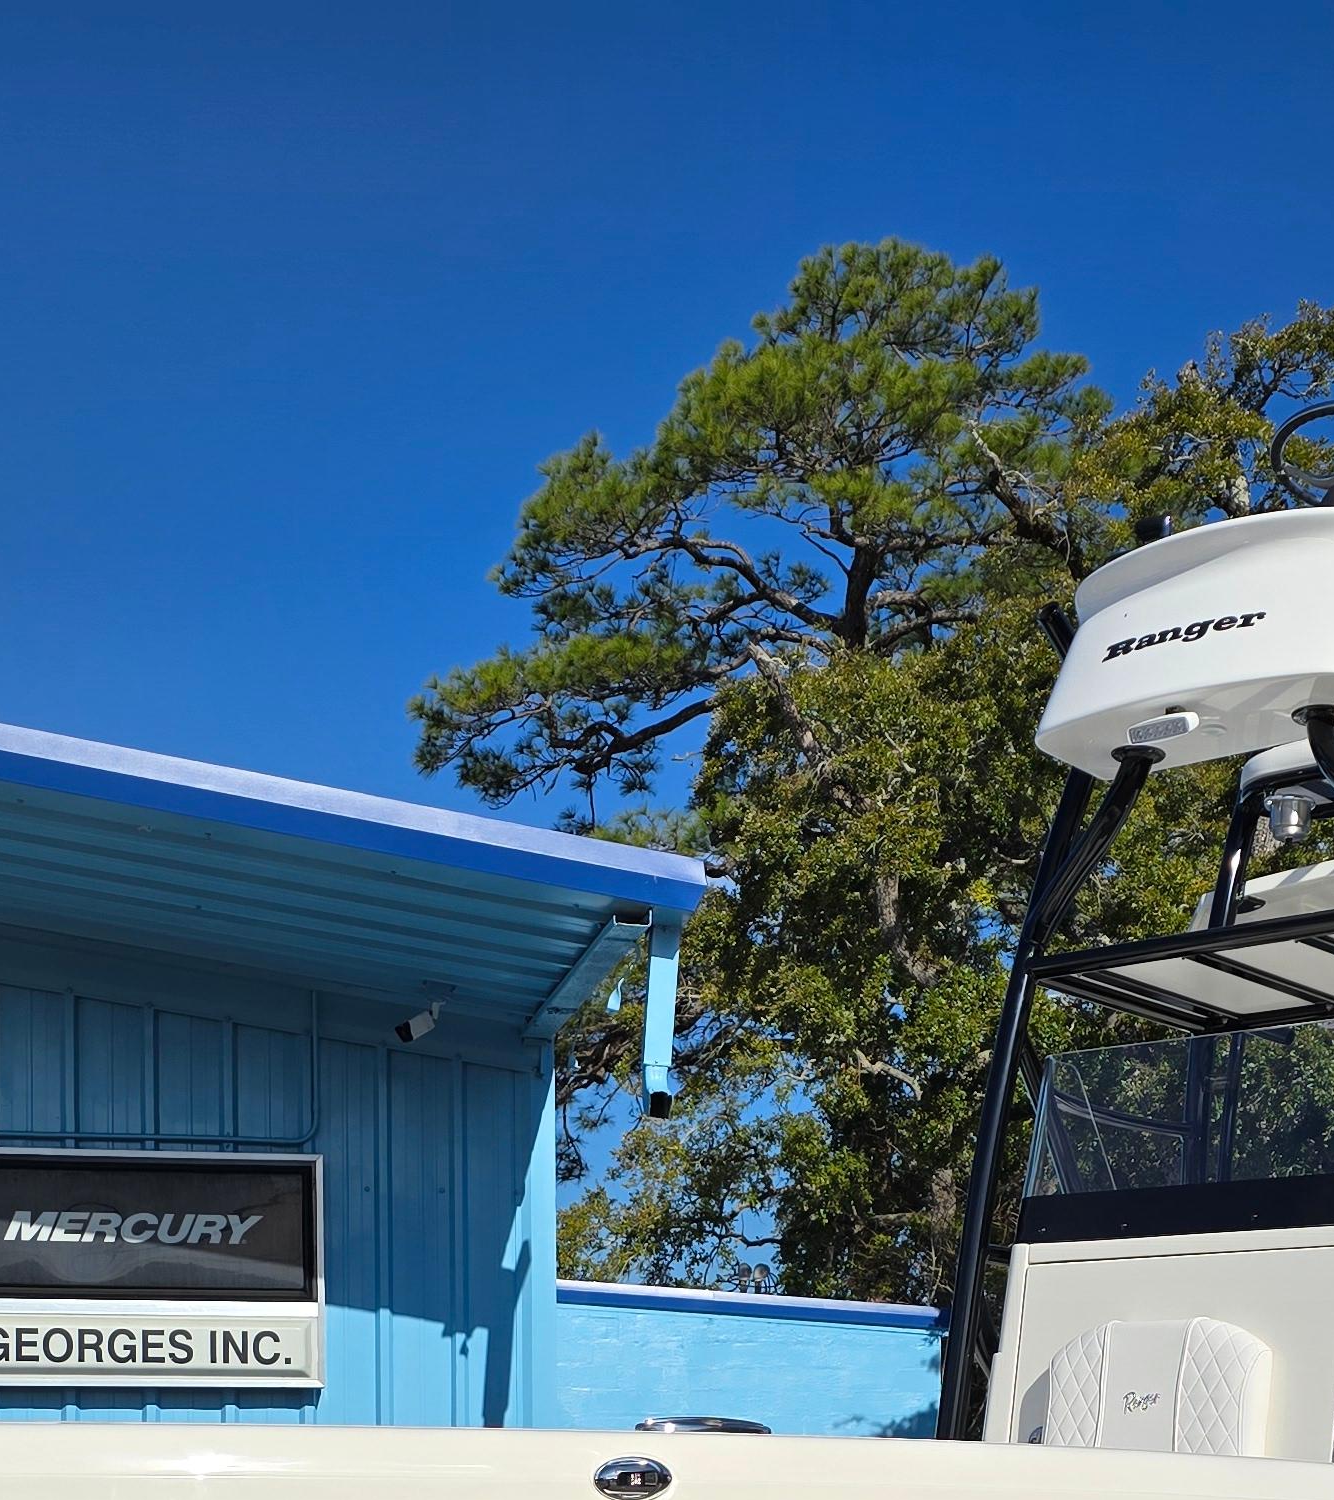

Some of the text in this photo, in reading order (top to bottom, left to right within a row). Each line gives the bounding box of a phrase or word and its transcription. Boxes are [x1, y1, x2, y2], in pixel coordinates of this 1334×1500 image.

[1102, 611, 1266, 663] Ranger
[3, 1210, 264, 1245] MERCURY
[209, 1330, 293, 1366] INC.
